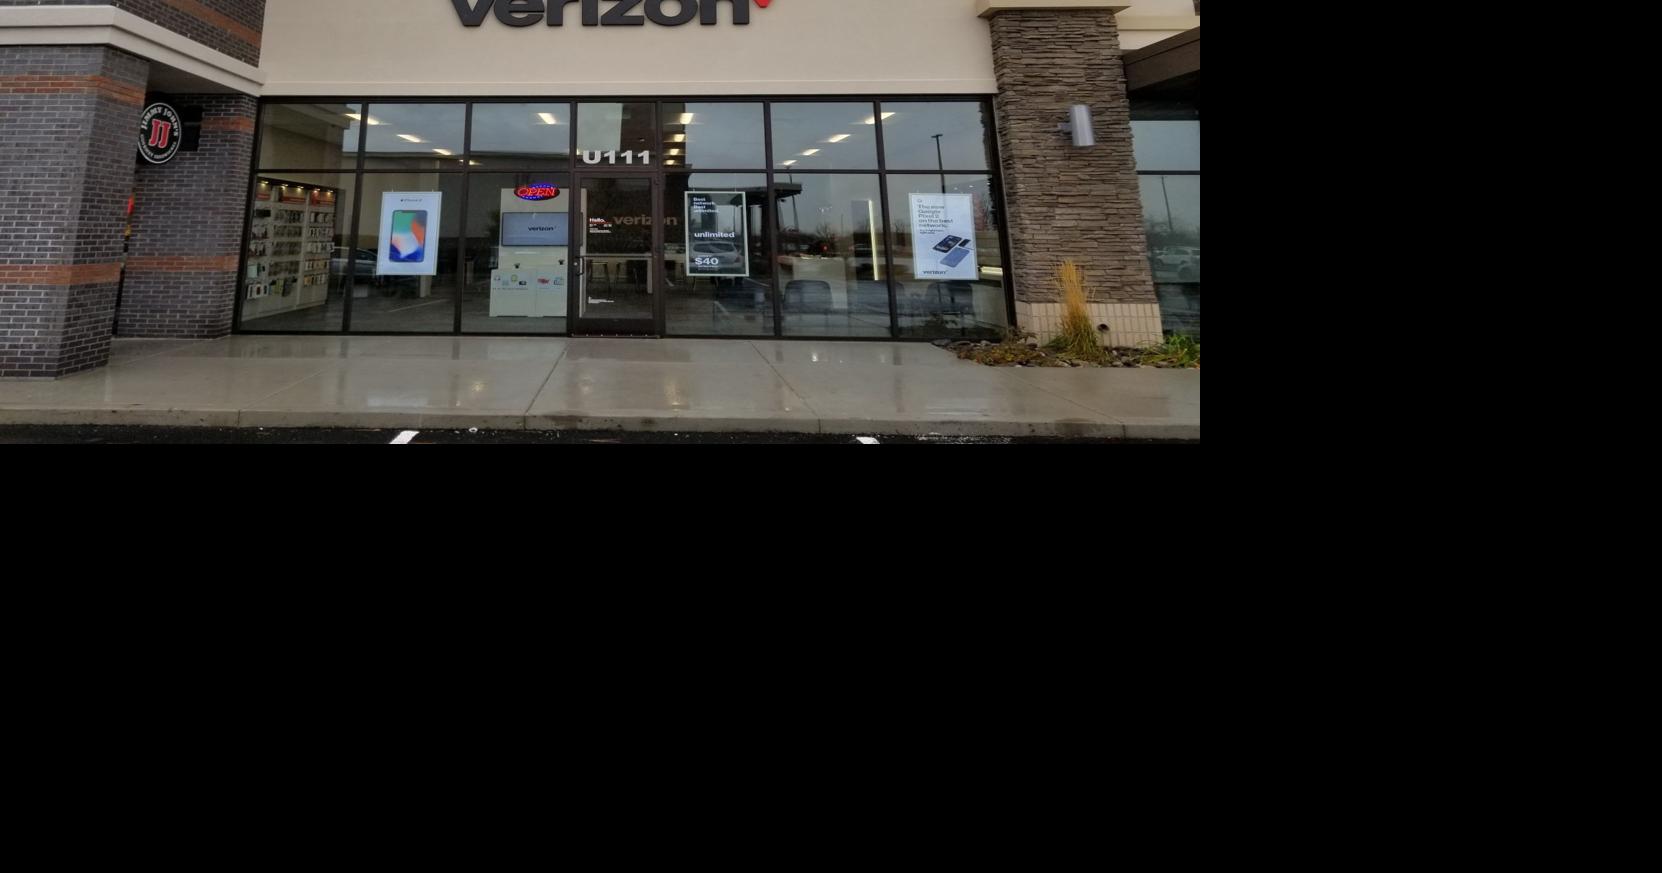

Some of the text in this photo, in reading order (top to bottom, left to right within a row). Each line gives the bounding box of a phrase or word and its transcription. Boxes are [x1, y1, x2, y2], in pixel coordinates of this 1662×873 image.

[454, 0, 750, 27] verizon
[582, 150, 650, 165] U111
[517, 186, 556, 197] OPEN
[612, 214, 678, 226] verizn
[694, 257, 719, 265] $40
